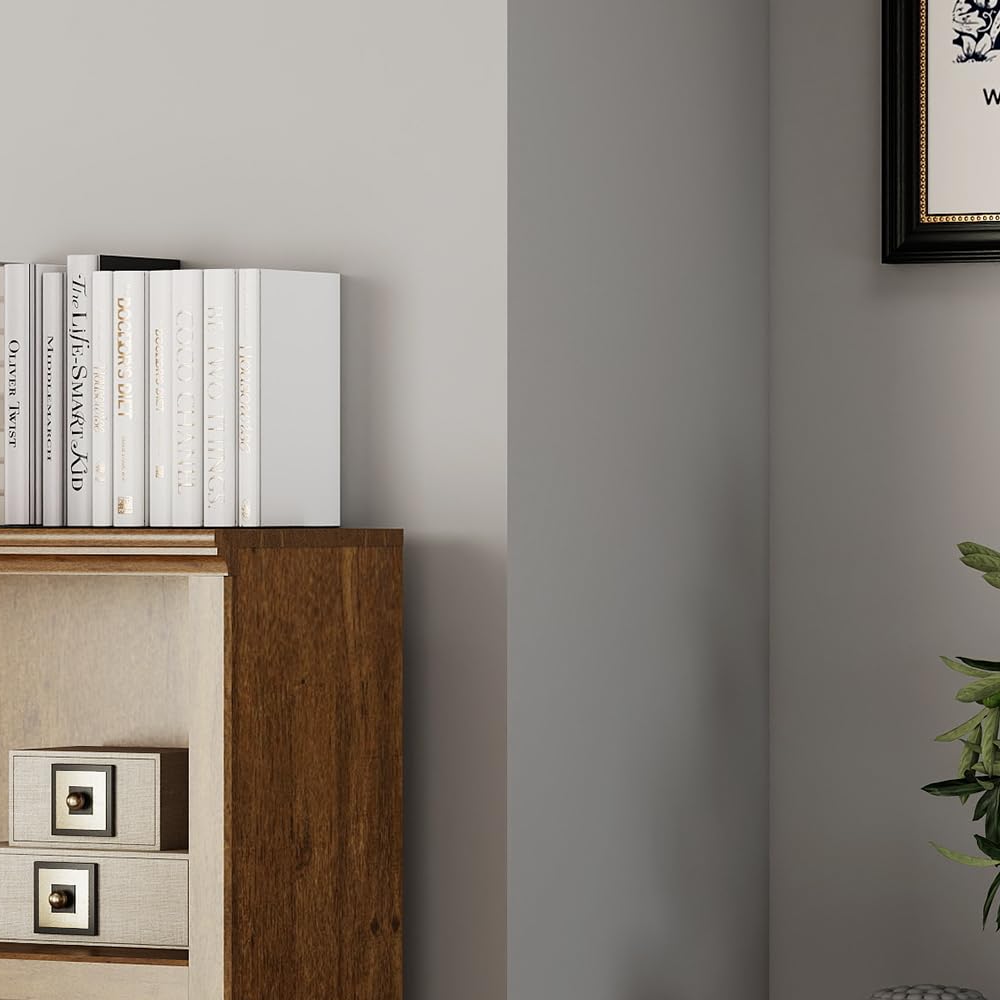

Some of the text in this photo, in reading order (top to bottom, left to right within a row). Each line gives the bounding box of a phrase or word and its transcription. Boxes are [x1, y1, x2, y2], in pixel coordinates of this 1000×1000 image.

[8, 339, 21, 448] OLIVER TWIST
[117, 383, 133, 420] DIET
